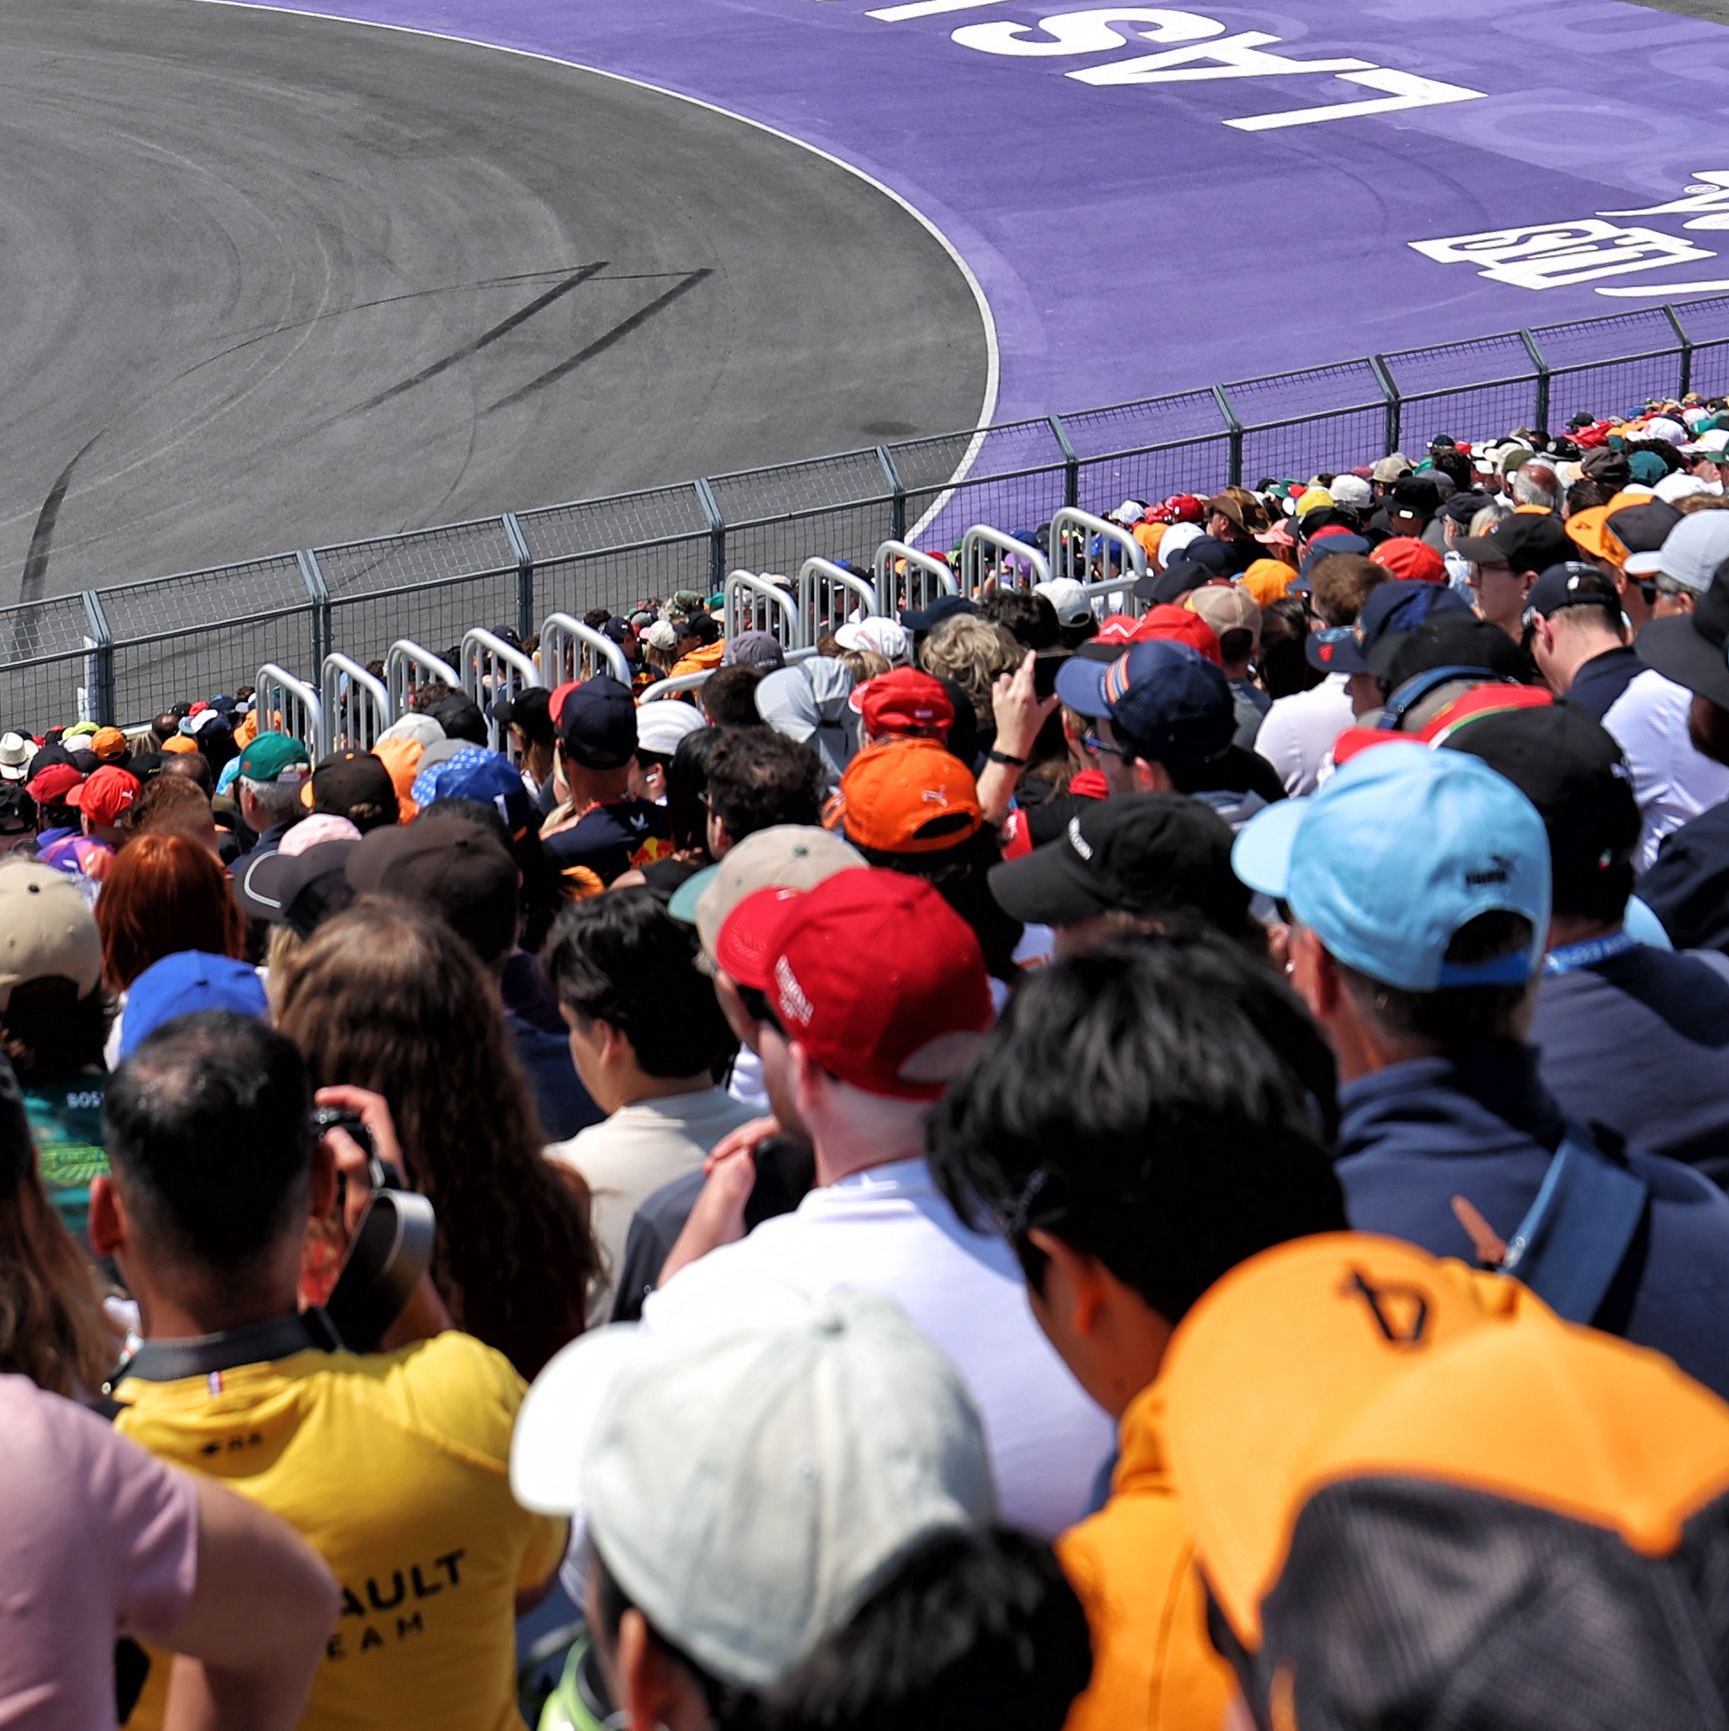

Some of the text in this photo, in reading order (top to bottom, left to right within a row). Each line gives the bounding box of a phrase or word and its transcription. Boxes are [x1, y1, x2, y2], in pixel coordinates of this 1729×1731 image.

[949, 6, 1491, 133] LAS
[66, 1090, 104, 1109] BOS
[340, 1546, 467, 1618] AULT
[325, 1610, 425, 1661] EAM
